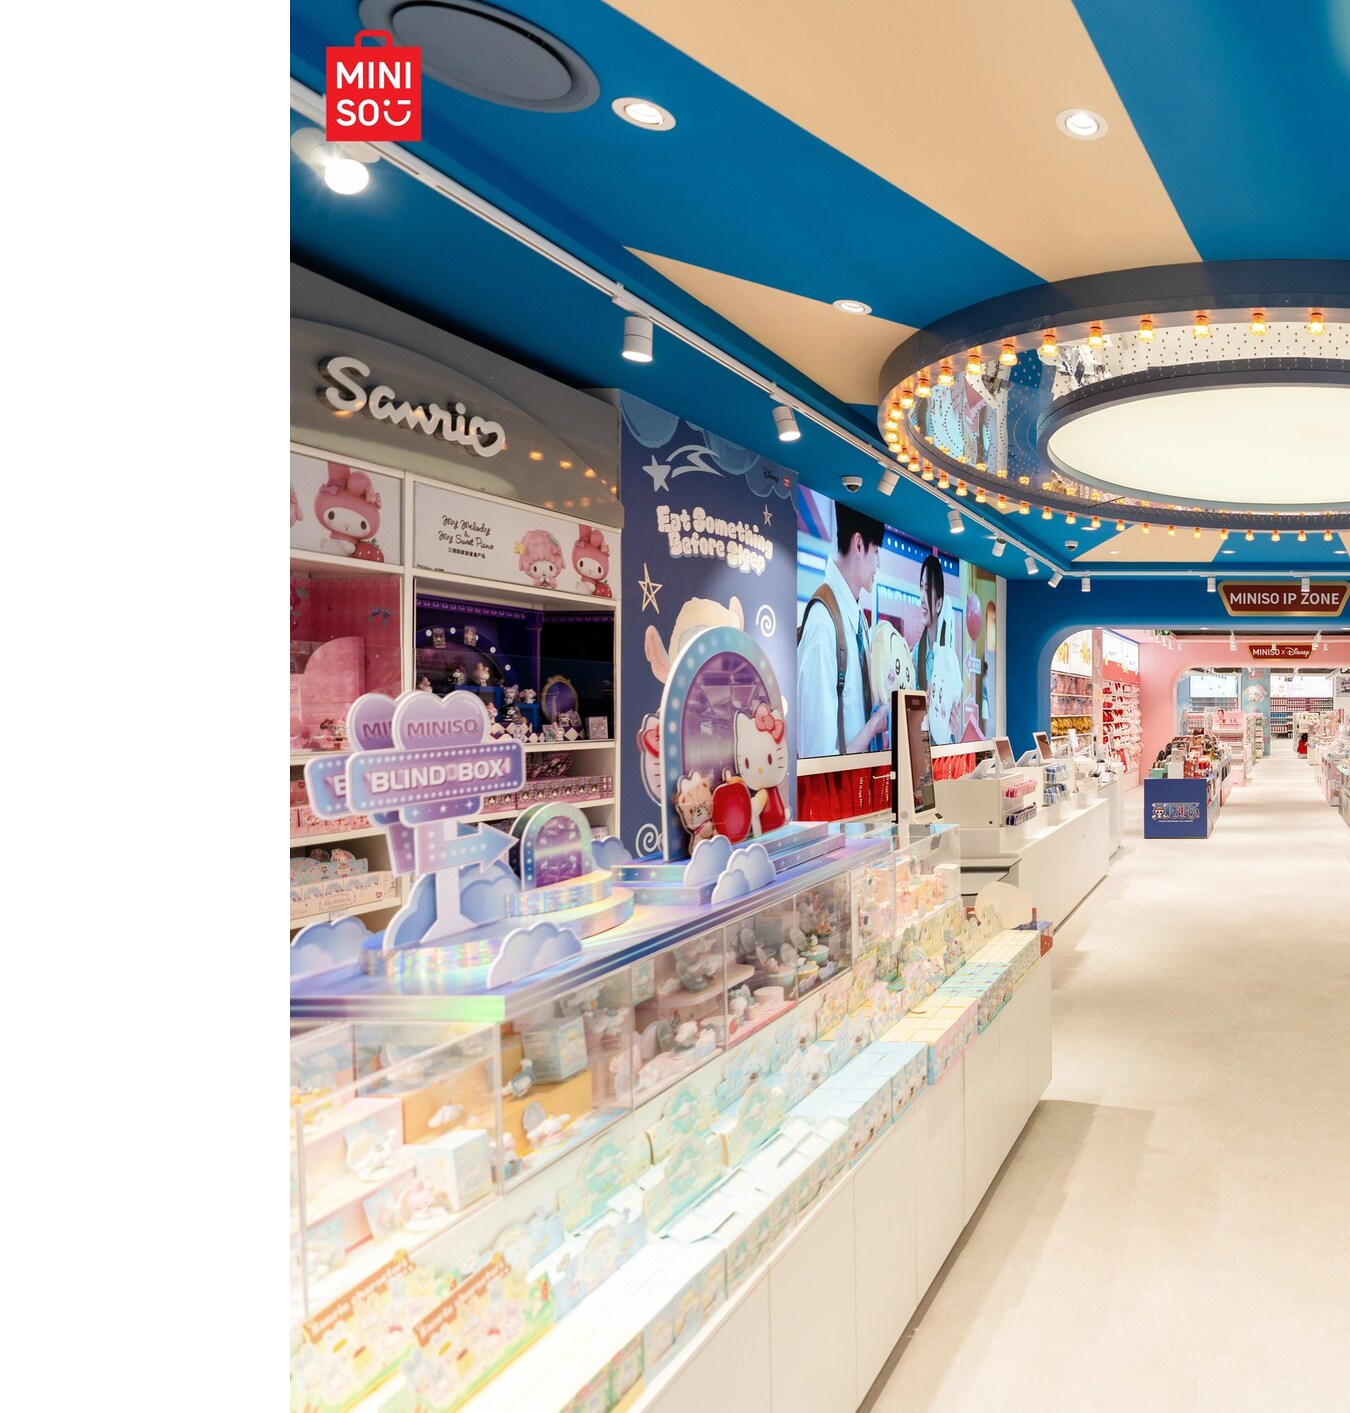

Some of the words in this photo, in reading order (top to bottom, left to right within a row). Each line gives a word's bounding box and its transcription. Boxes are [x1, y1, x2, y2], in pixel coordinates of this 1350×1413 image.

[325, 354, 507, 458] Sanrio
[461, 519, 491, 536] Melody
[656, 504, 691, 533] Eat
[692, 507, 773, 560] Something
[667, 530, 726, 557] Before
[726, 540, 766, 574] Sleep
[1230, 592, 1280, 605] MINISO
[1283, 592, 1297, 605] IP
[1301, 592, 1339, 605] ZONE
[1252, 648, 1280, 656] MINISO
[1285, 646, 1310, 658] Disney
[407, 718, 478, 738] MINISO
[371, 764, 446, 794] BLIND
[458, 758, 504, 782] BOX
